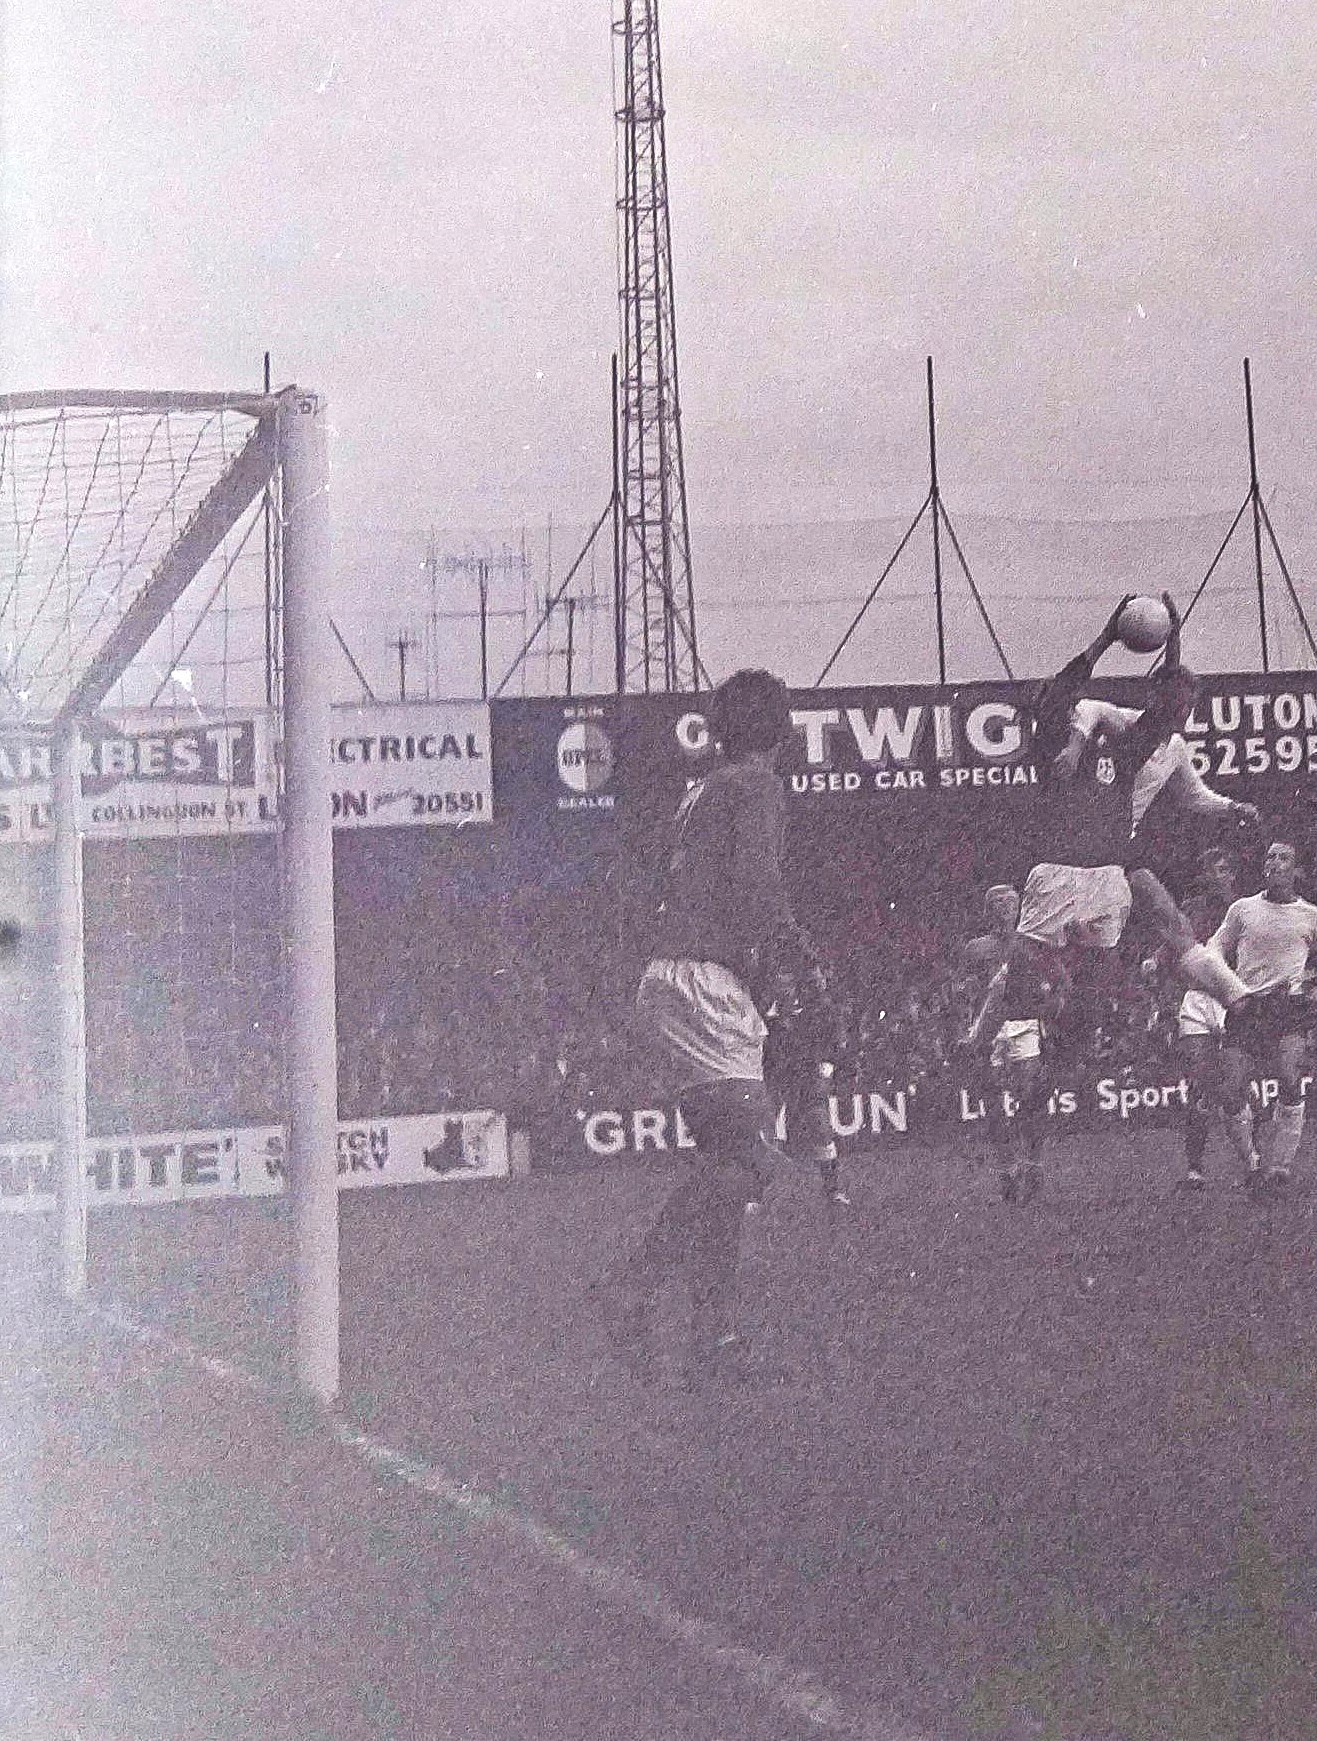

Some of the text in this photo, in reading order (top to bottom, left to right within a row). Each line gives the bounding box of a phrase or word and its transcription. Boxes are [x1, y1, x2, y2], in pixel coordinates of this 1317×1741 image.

[331, 732, 484, 763] CTRICAL
[789, 702, 1036, 764] TWIG
[791, 772, 861, 794] USED
[875, 770, 927, 790] CAR
